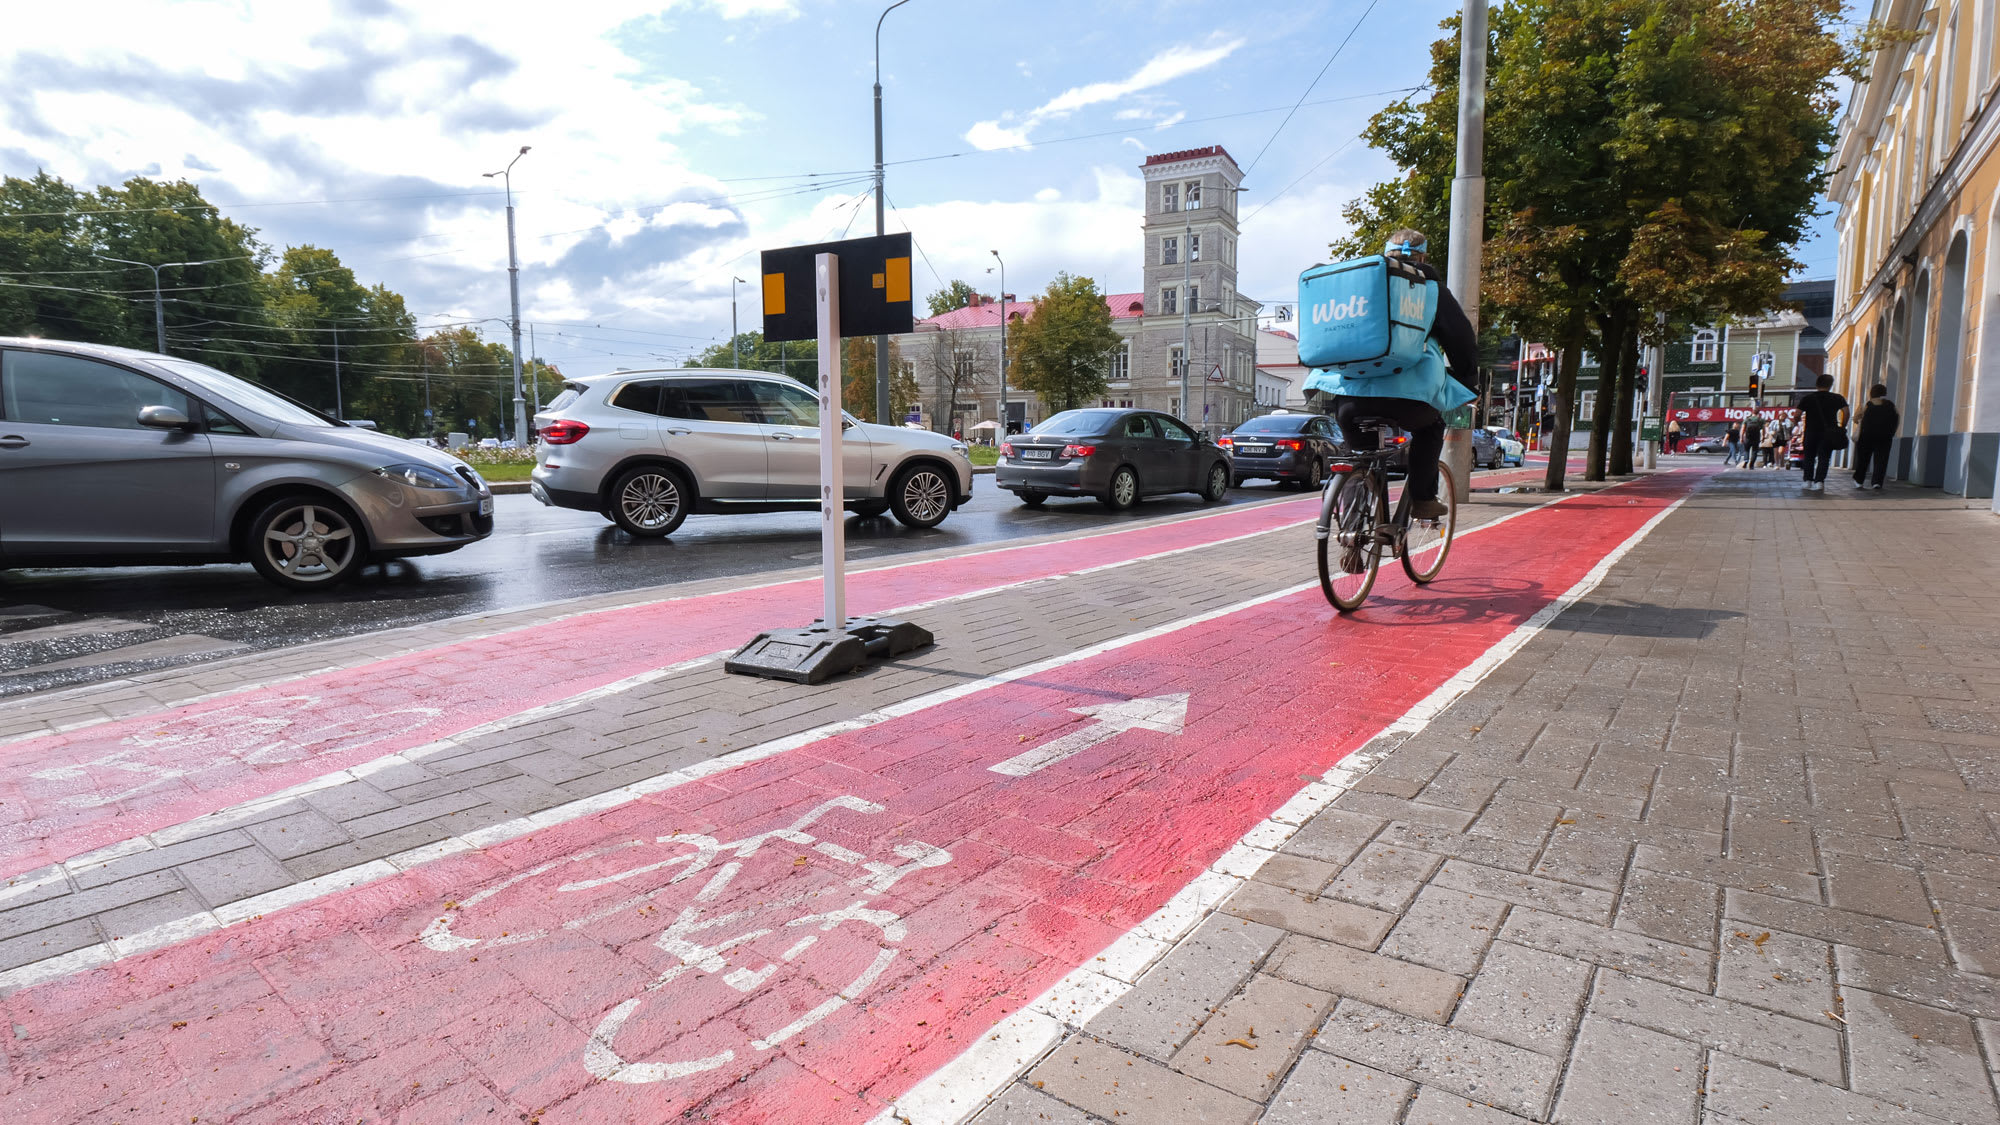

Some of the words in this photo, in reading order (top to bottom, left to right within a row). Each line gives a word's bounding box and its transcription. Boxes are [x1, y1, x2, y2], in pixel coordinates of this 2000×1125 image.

[1312, 295, 1368, 325] Wolt
[1400, 296, 1425, 320] Wolt
[1324, 322, 1355, 332] PARTNER
[1724, 408, 1752, 420] HOP
